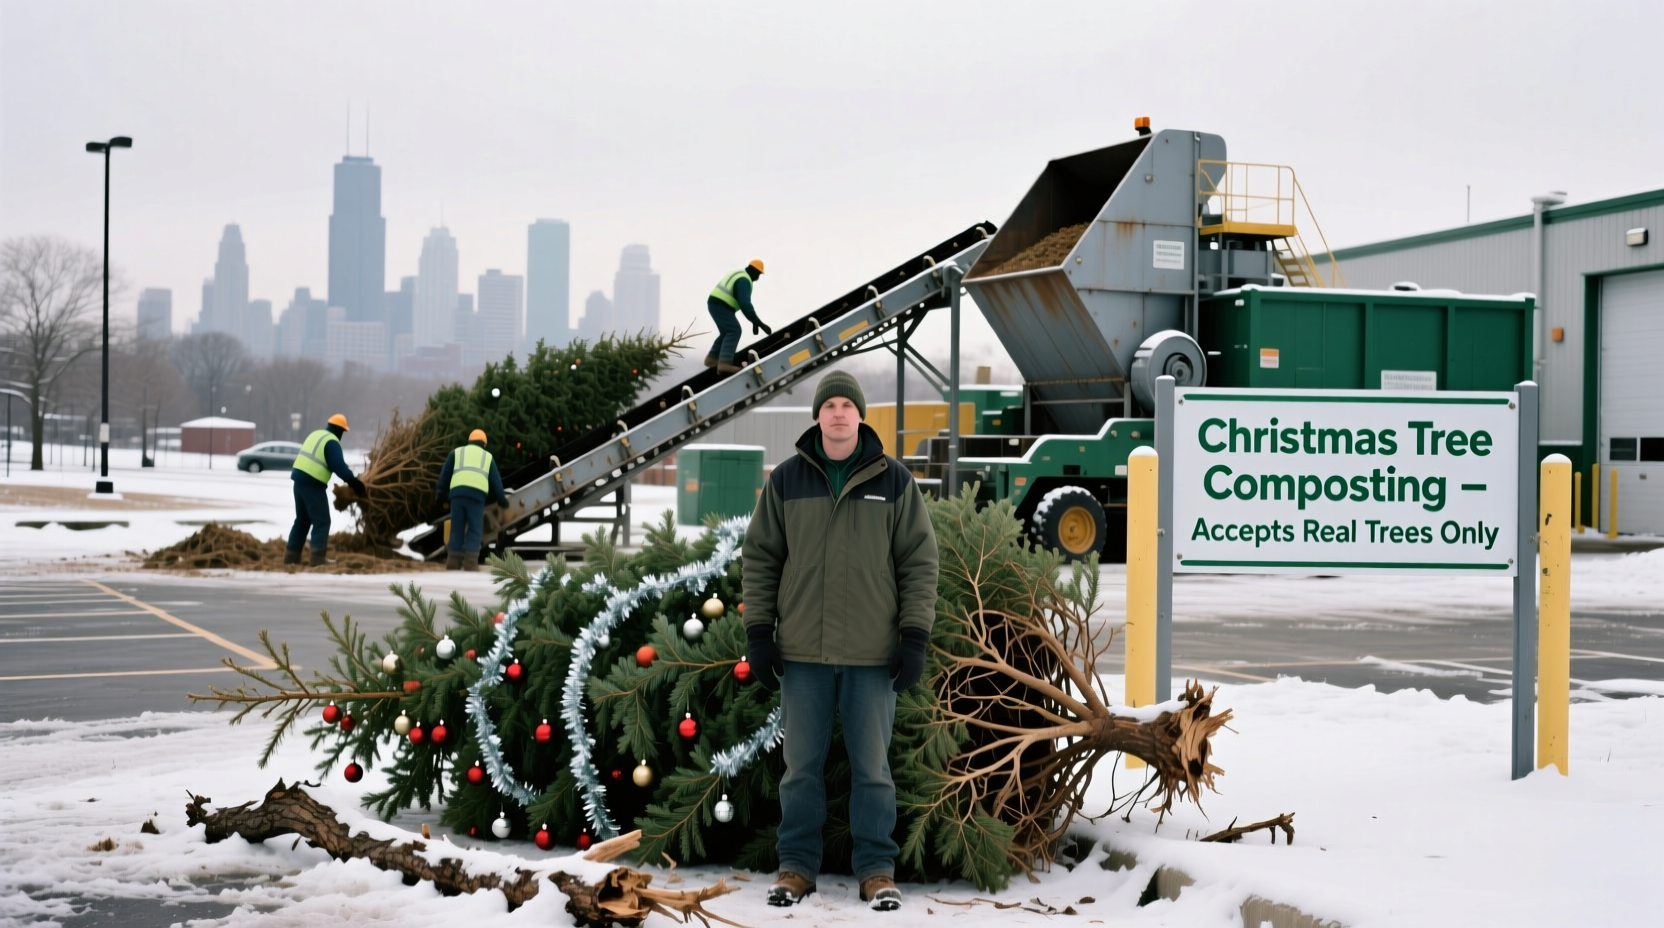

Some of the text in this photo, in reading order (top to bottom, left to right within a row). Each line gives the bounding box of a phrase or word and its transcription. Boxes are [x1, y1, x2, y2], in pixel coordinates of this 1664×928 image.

[1197, 416, 1493, 457] Christmas Tree
[1203, 464, 1447, 512] Composting
[1190, 517, 1500, 551] Accepts Real Trees Only
